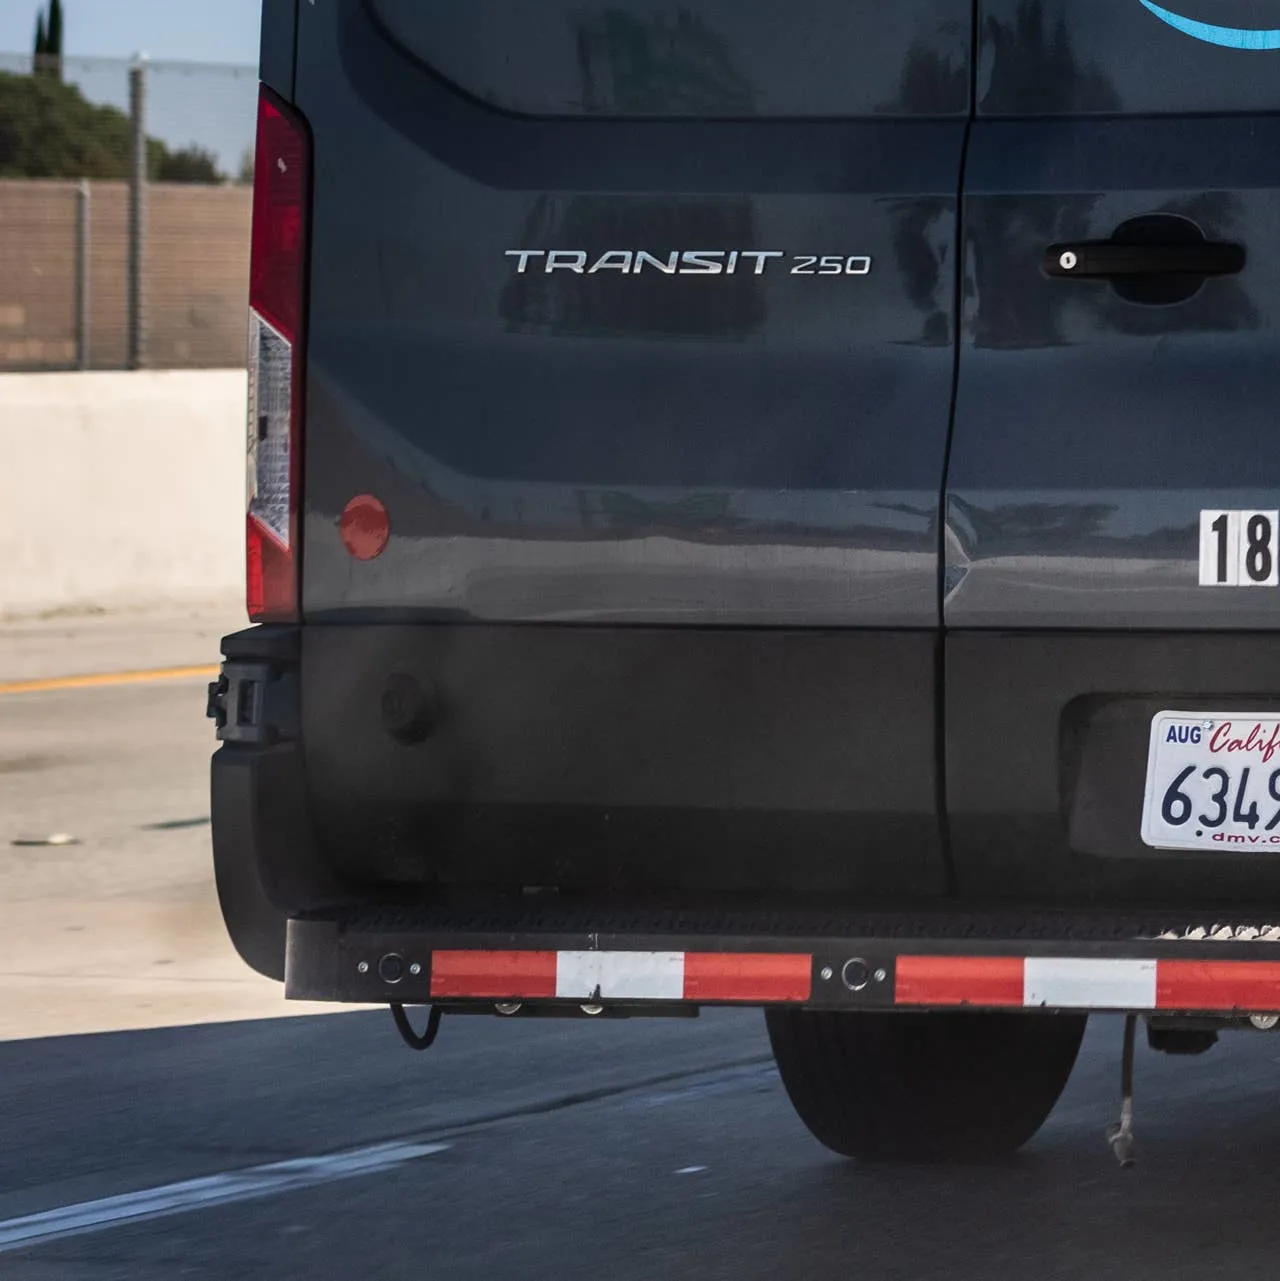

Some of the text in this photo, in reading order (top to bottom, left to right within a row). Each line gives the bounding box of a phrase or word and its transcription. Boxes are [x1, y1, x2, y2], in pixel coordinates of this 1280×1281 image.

[504, 250, 872, 275] TRANSIT 250
[1211, 514, 1273, 583] 18
[1165, 724, 1202, 745] AUG
